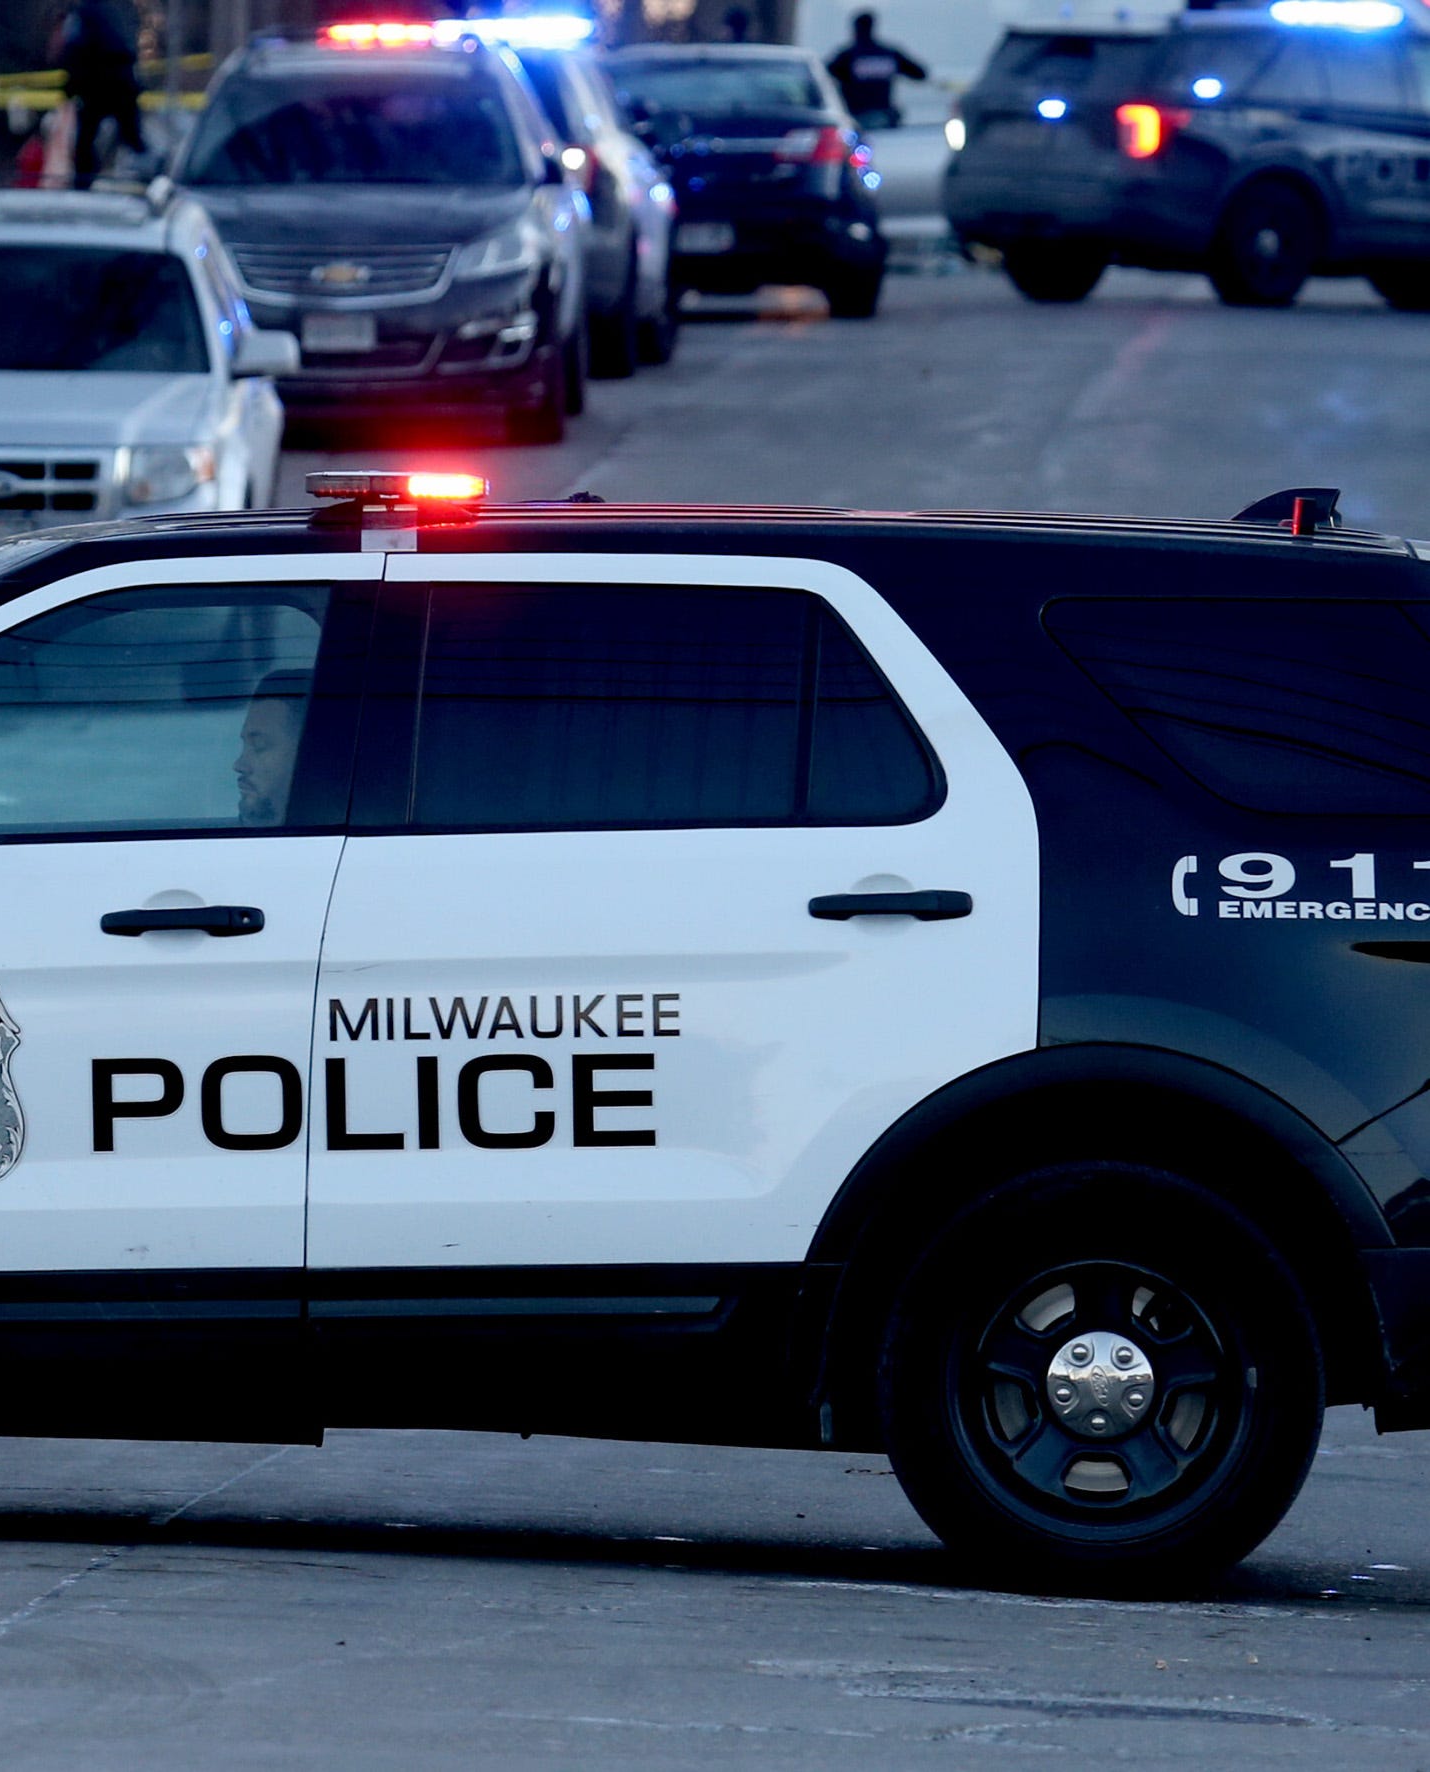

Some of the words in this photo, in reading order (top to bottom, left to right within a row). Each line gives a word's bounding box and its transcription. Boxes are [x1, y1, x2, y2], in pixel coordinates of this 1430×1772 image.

[1218, 852, 1430, 899] 91
[1218, 900, 1430, 921] EMERGENC
[328, 993, 681, 1042] MILWAUKEE
[91, 1053, 657, 1152] POLICE
